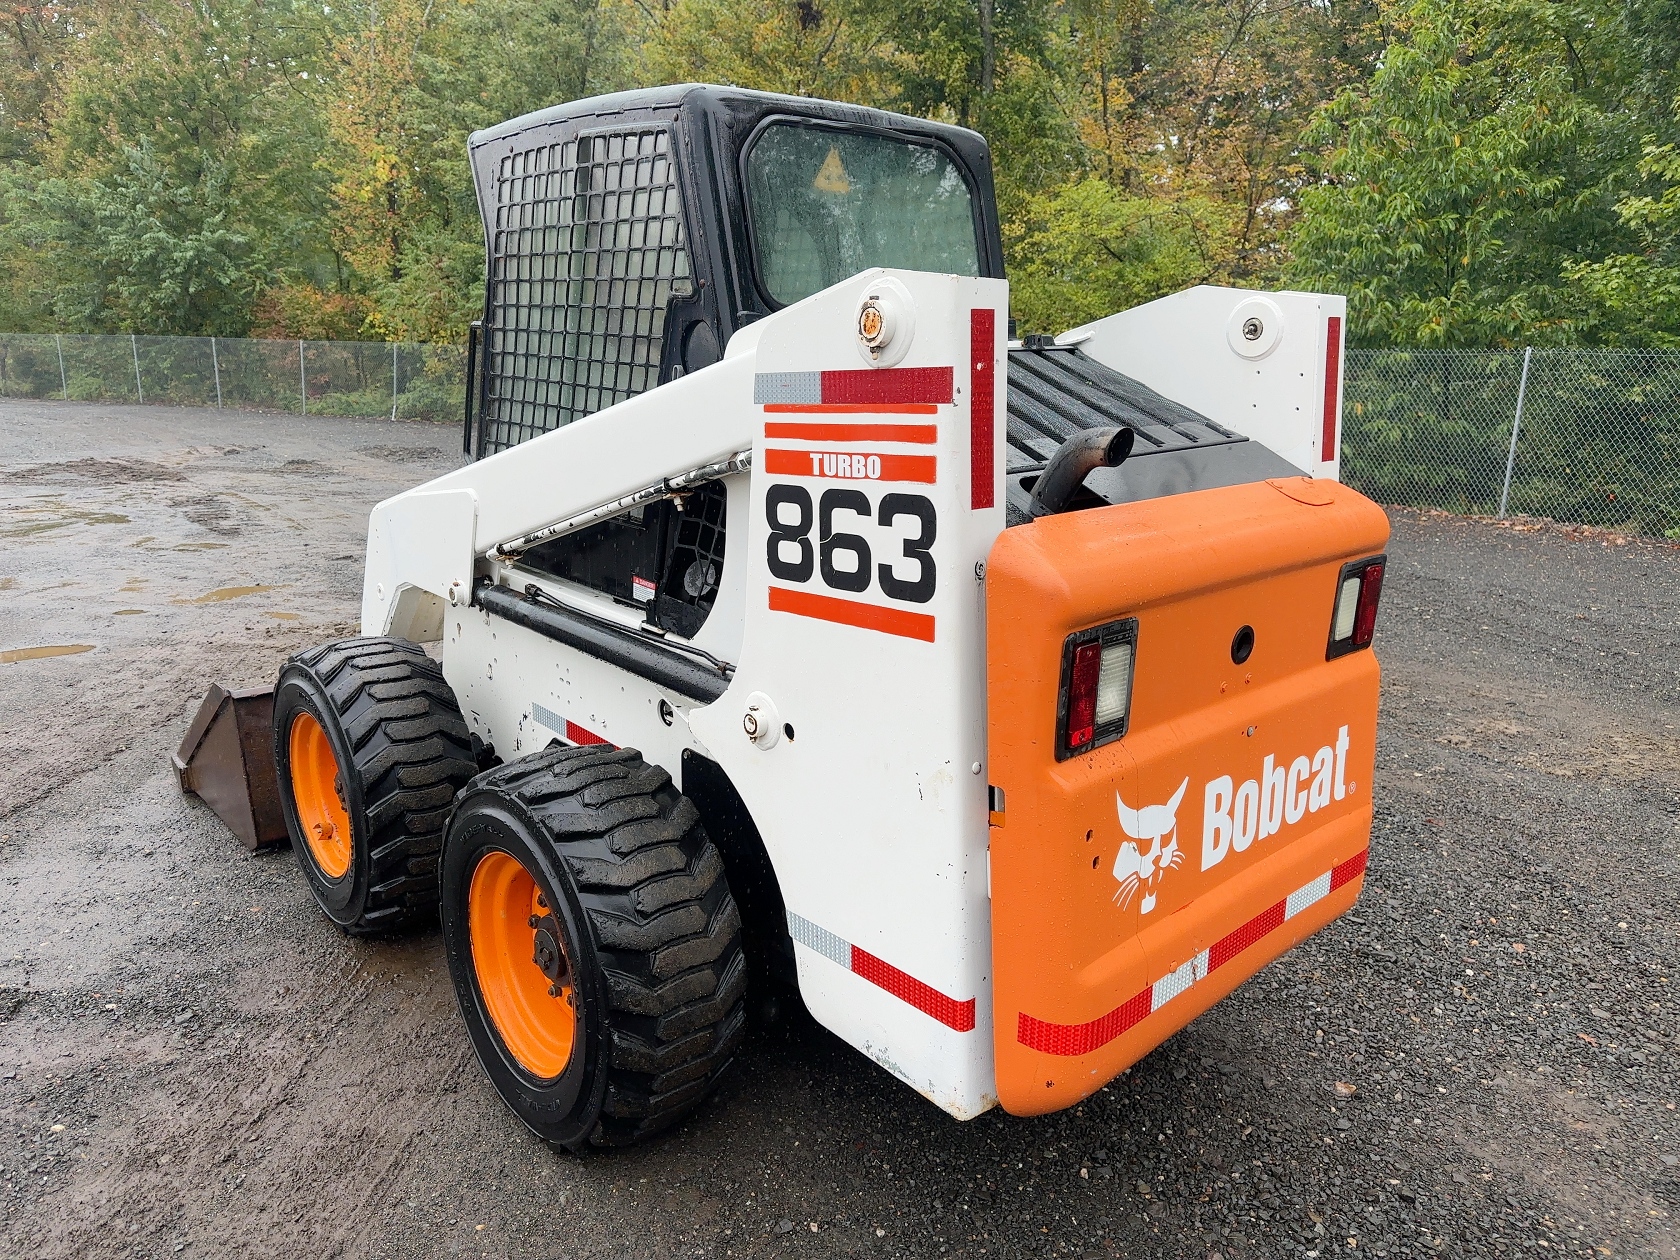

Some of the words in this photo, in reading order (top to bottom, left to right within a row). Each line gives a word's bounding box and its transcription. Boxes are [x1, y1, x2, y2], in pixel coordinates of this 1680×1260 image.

[809, 453, 881, 479] TURBO
[765, 483, 937, 604] 863
[1200, 724, 1350, 873] Bobcat
